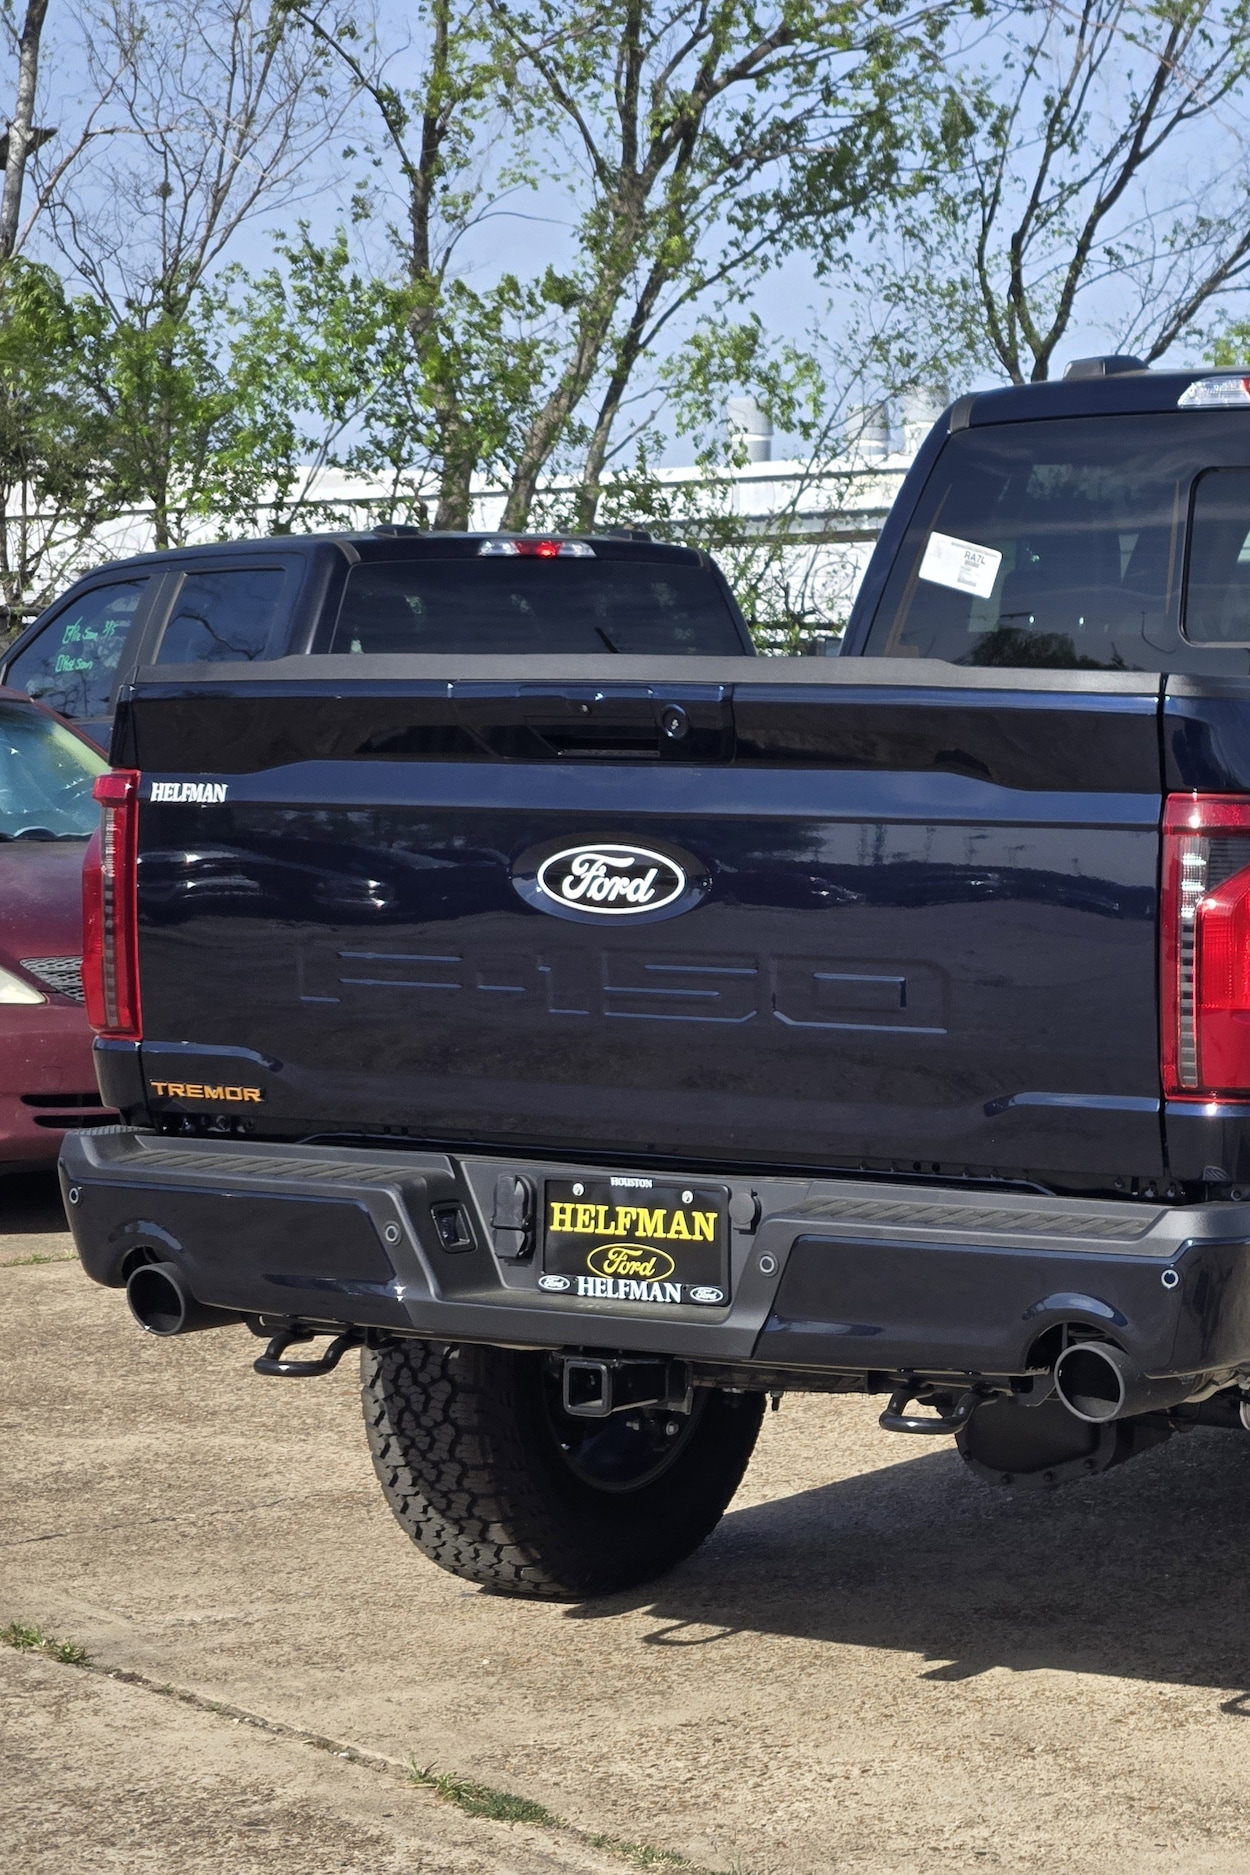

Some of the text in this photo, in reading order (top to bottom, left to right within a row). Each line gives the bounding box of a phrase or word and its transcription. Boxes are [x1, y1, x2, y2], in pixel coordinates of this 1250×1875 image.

[964, 551, 986, 565] RA7L
[150, 782, 229, 803] HELFMAN
[562, 853, 659, 903] Ford
[150, 1081, 264, 1102] TREMOR
[610, 1176, 653, 1188] HOUSTON
[550, 1202, 718, 1242] HELFMAN
[603, 1247, 657, 1277] Ford
[577, 1275, 682, 1303] HELFMAN
